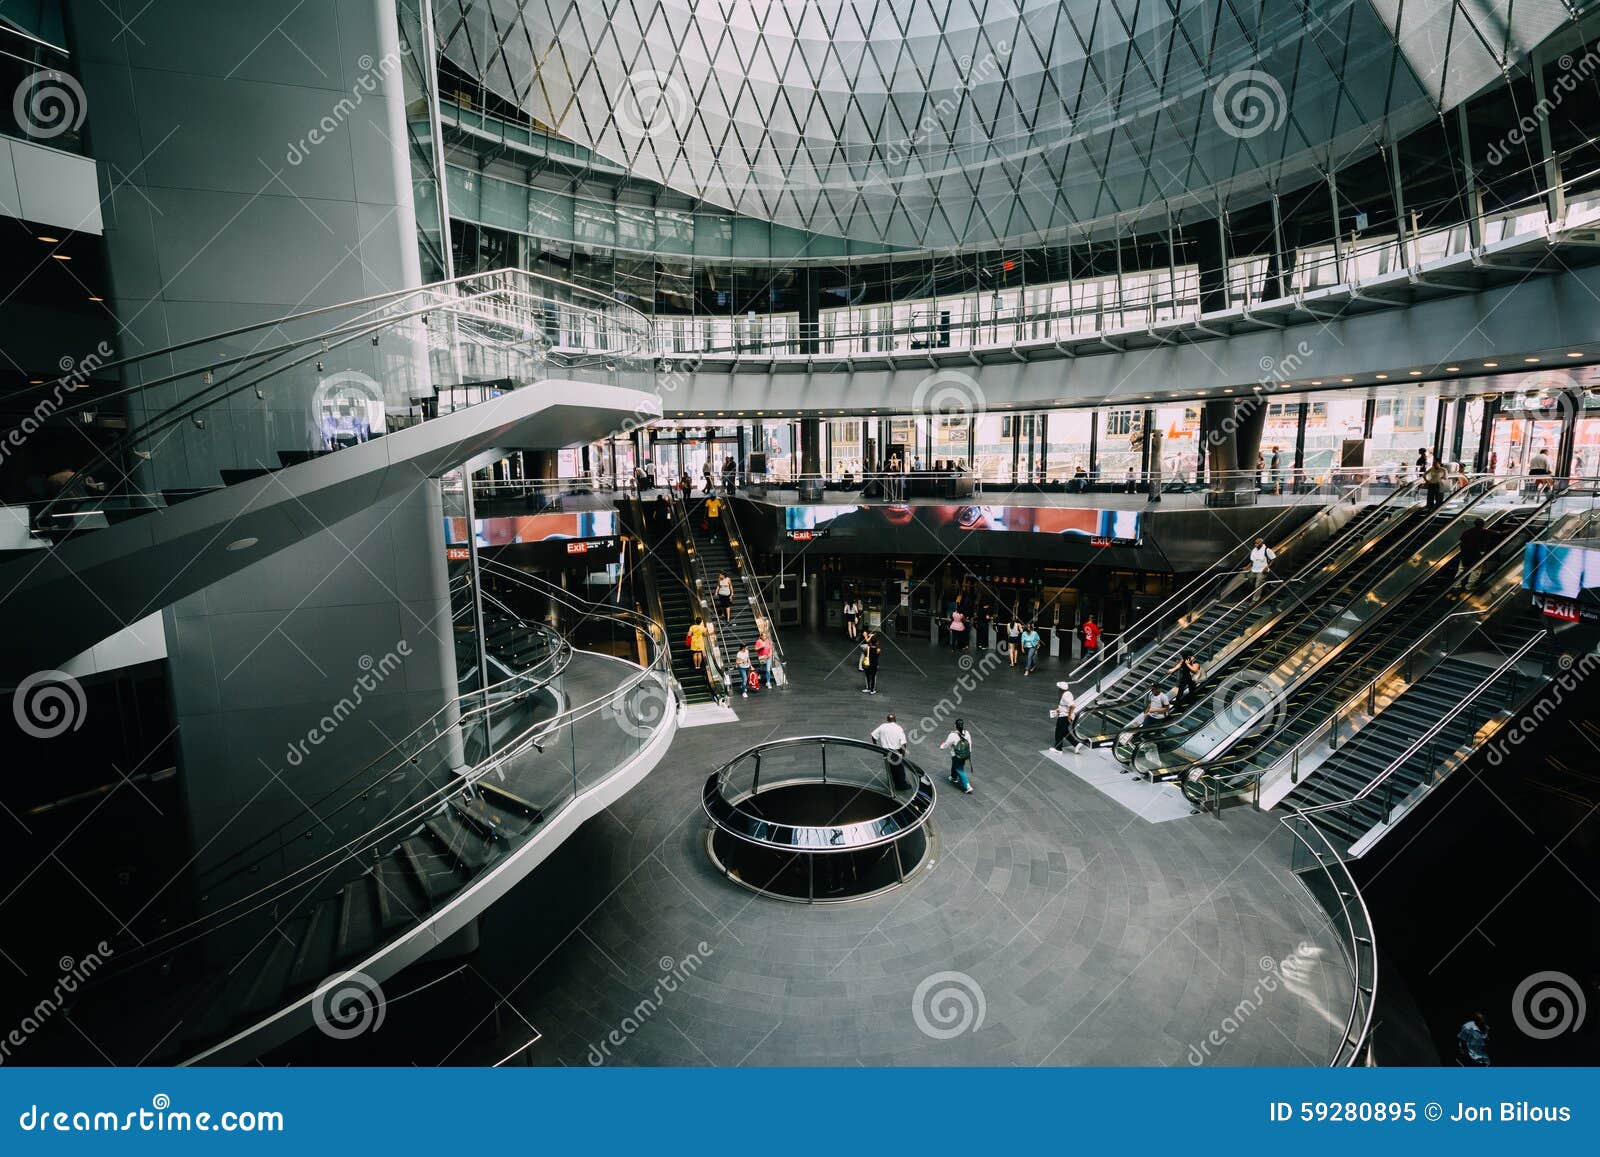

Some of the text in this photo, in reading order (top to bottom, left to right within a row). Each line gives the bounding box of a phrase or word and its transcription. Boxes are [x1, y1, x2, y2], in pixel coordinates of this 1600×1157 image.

[793, 530, 811, 539] Exit
[566, 542, 586, 553] Exit
[1543, 598, 1576, 619] Exit
